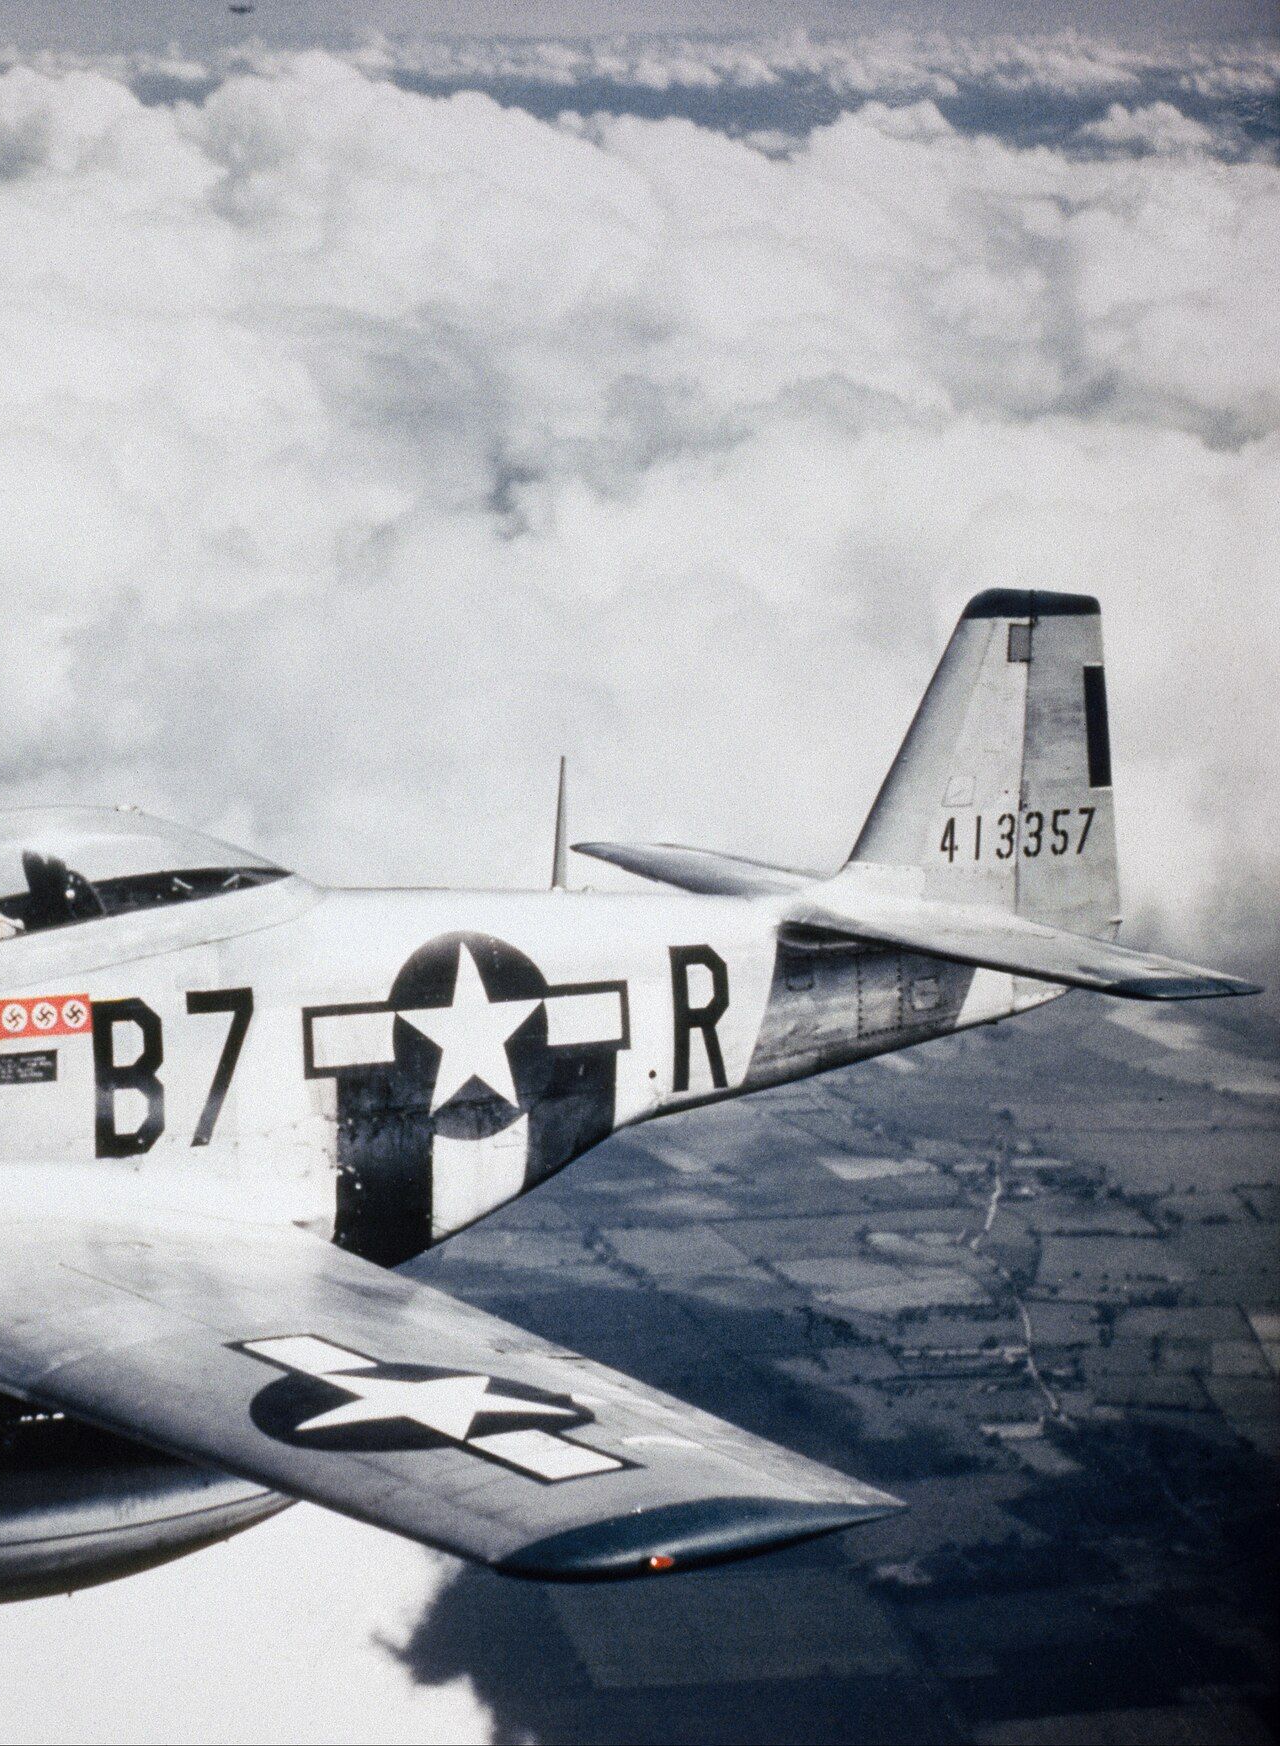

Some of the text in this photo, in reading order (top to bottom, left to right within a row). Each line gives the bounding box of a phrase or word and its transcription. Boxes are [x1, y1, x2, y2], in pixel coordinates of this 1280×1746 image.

[940, 807, 1096, 863] 413357
[91, 987, 254, 1159] B7
[669, 944, 730, 1092] R
